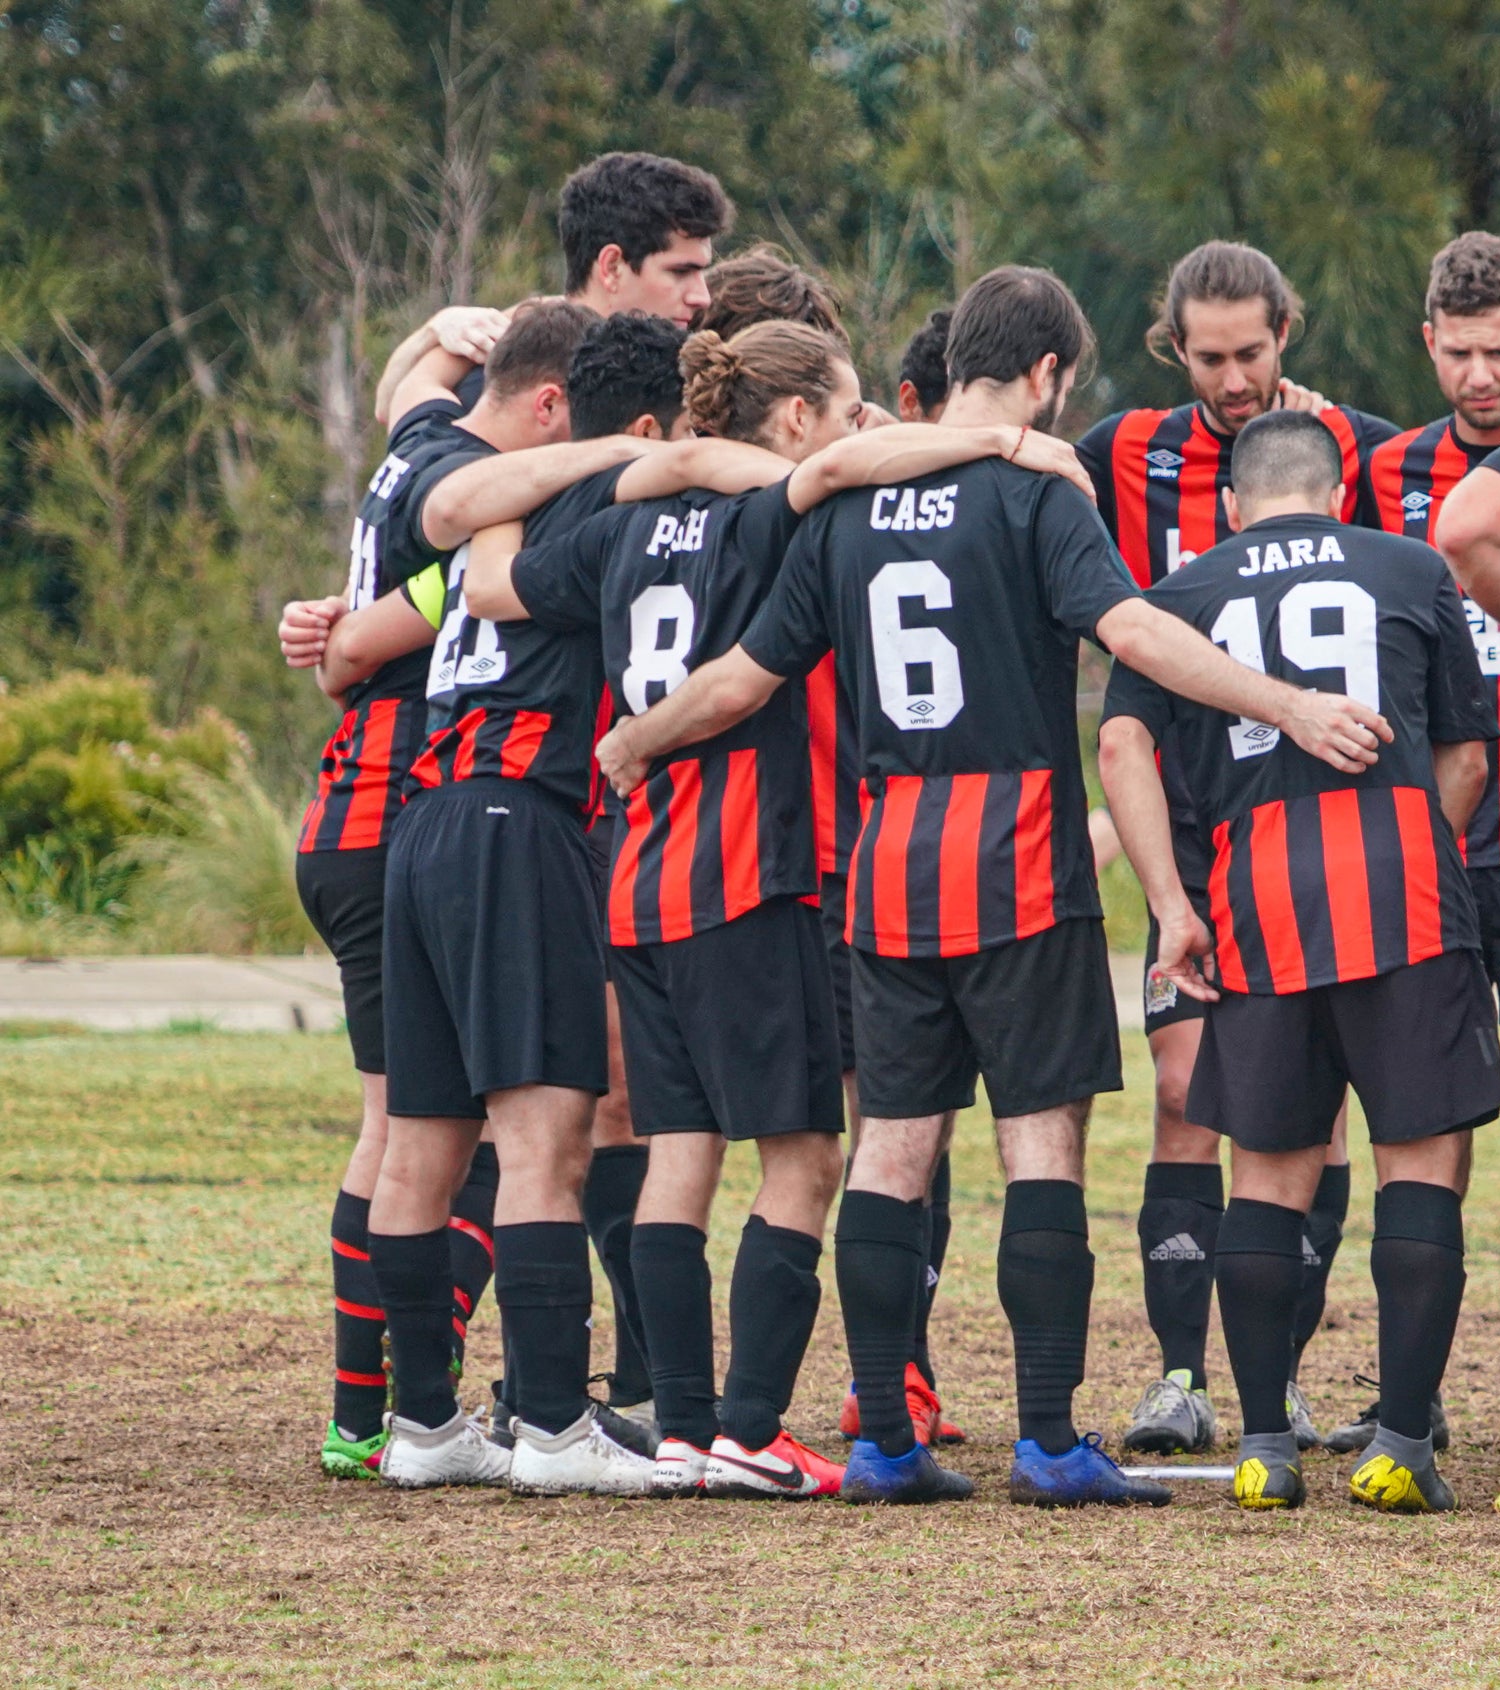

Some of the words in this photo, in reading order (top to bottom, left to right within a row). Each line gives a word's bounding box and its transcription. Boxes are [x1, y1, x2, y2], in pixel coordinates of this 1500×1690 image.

[869, 484, 958, 531] CASS
[1238, 535, 1345, 577] JARA
[622, 584, 695, 716] 8
[868, 560, 965, 731] 6
[1210, 580, 1380, 761] 19
[1149, 1249, 1206, 1261] adidas
